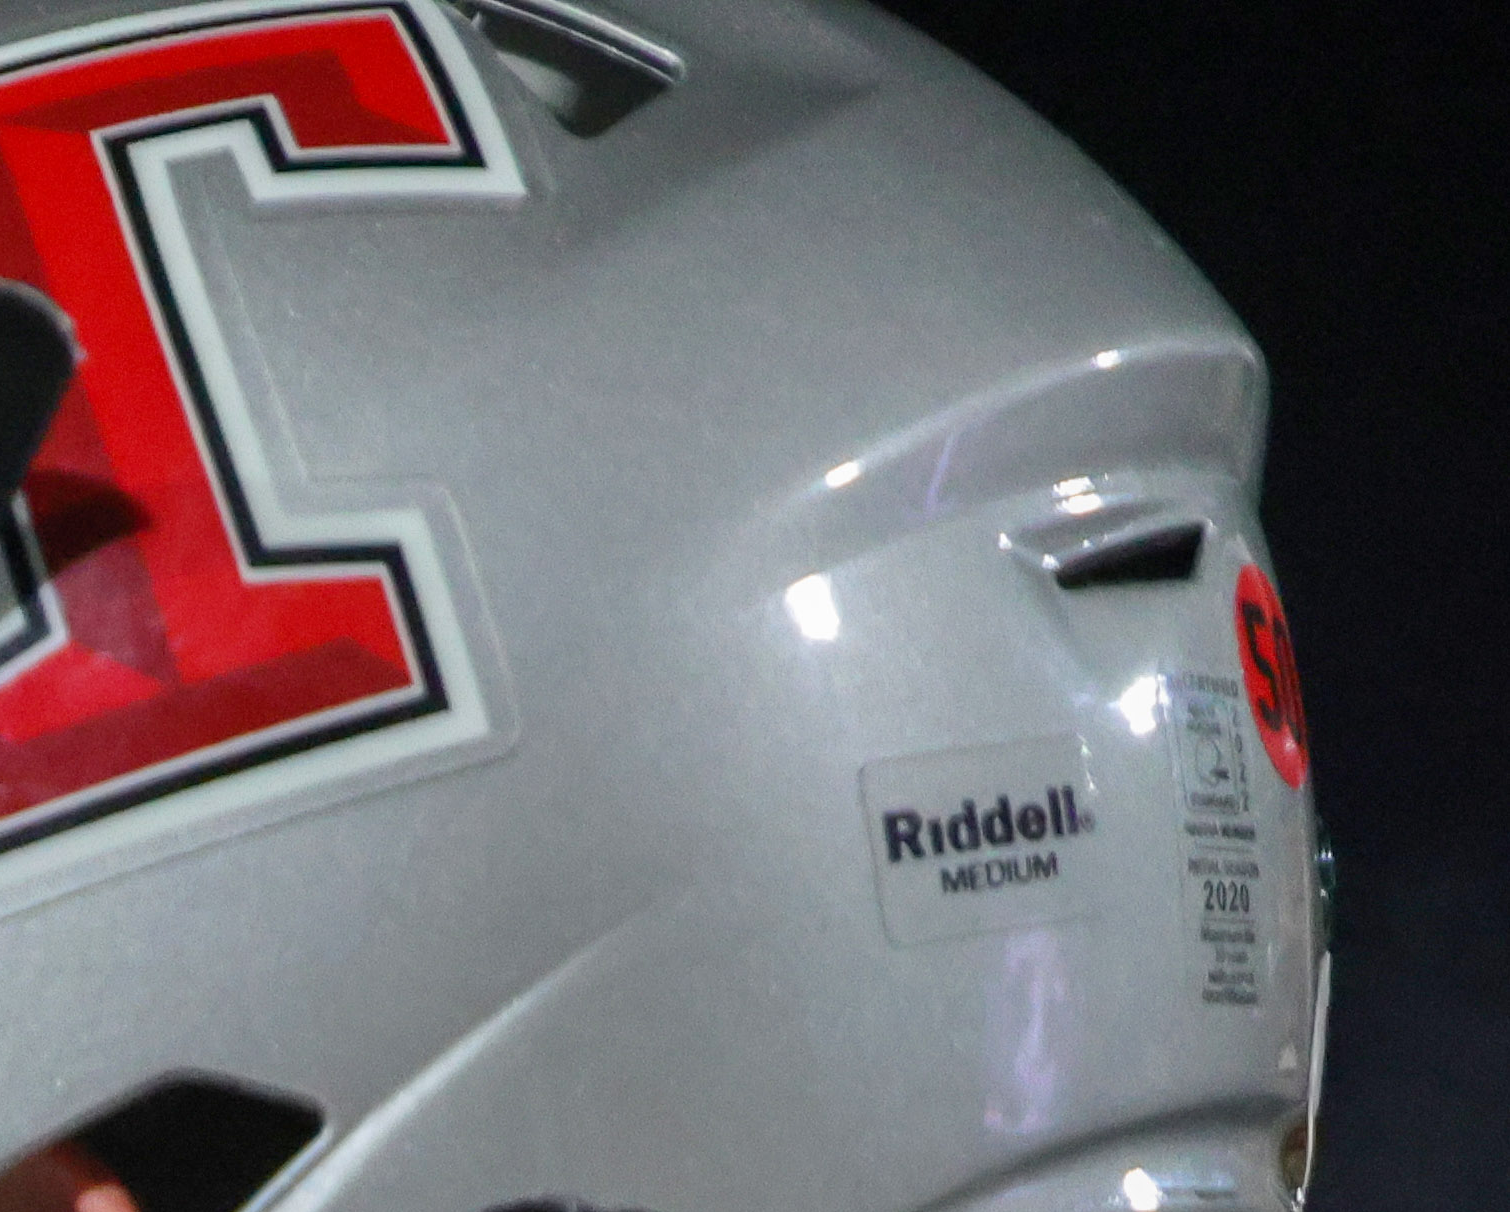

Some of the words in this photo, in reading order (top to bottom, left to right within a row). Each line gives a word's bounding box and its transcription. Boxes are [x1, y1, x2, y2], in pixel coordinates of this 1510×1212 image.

[883, 785, 1079, 863] Riddell
[940, 851, 1059, 893] MEDIUM
[1203, 879, 1251, 913] 2020
